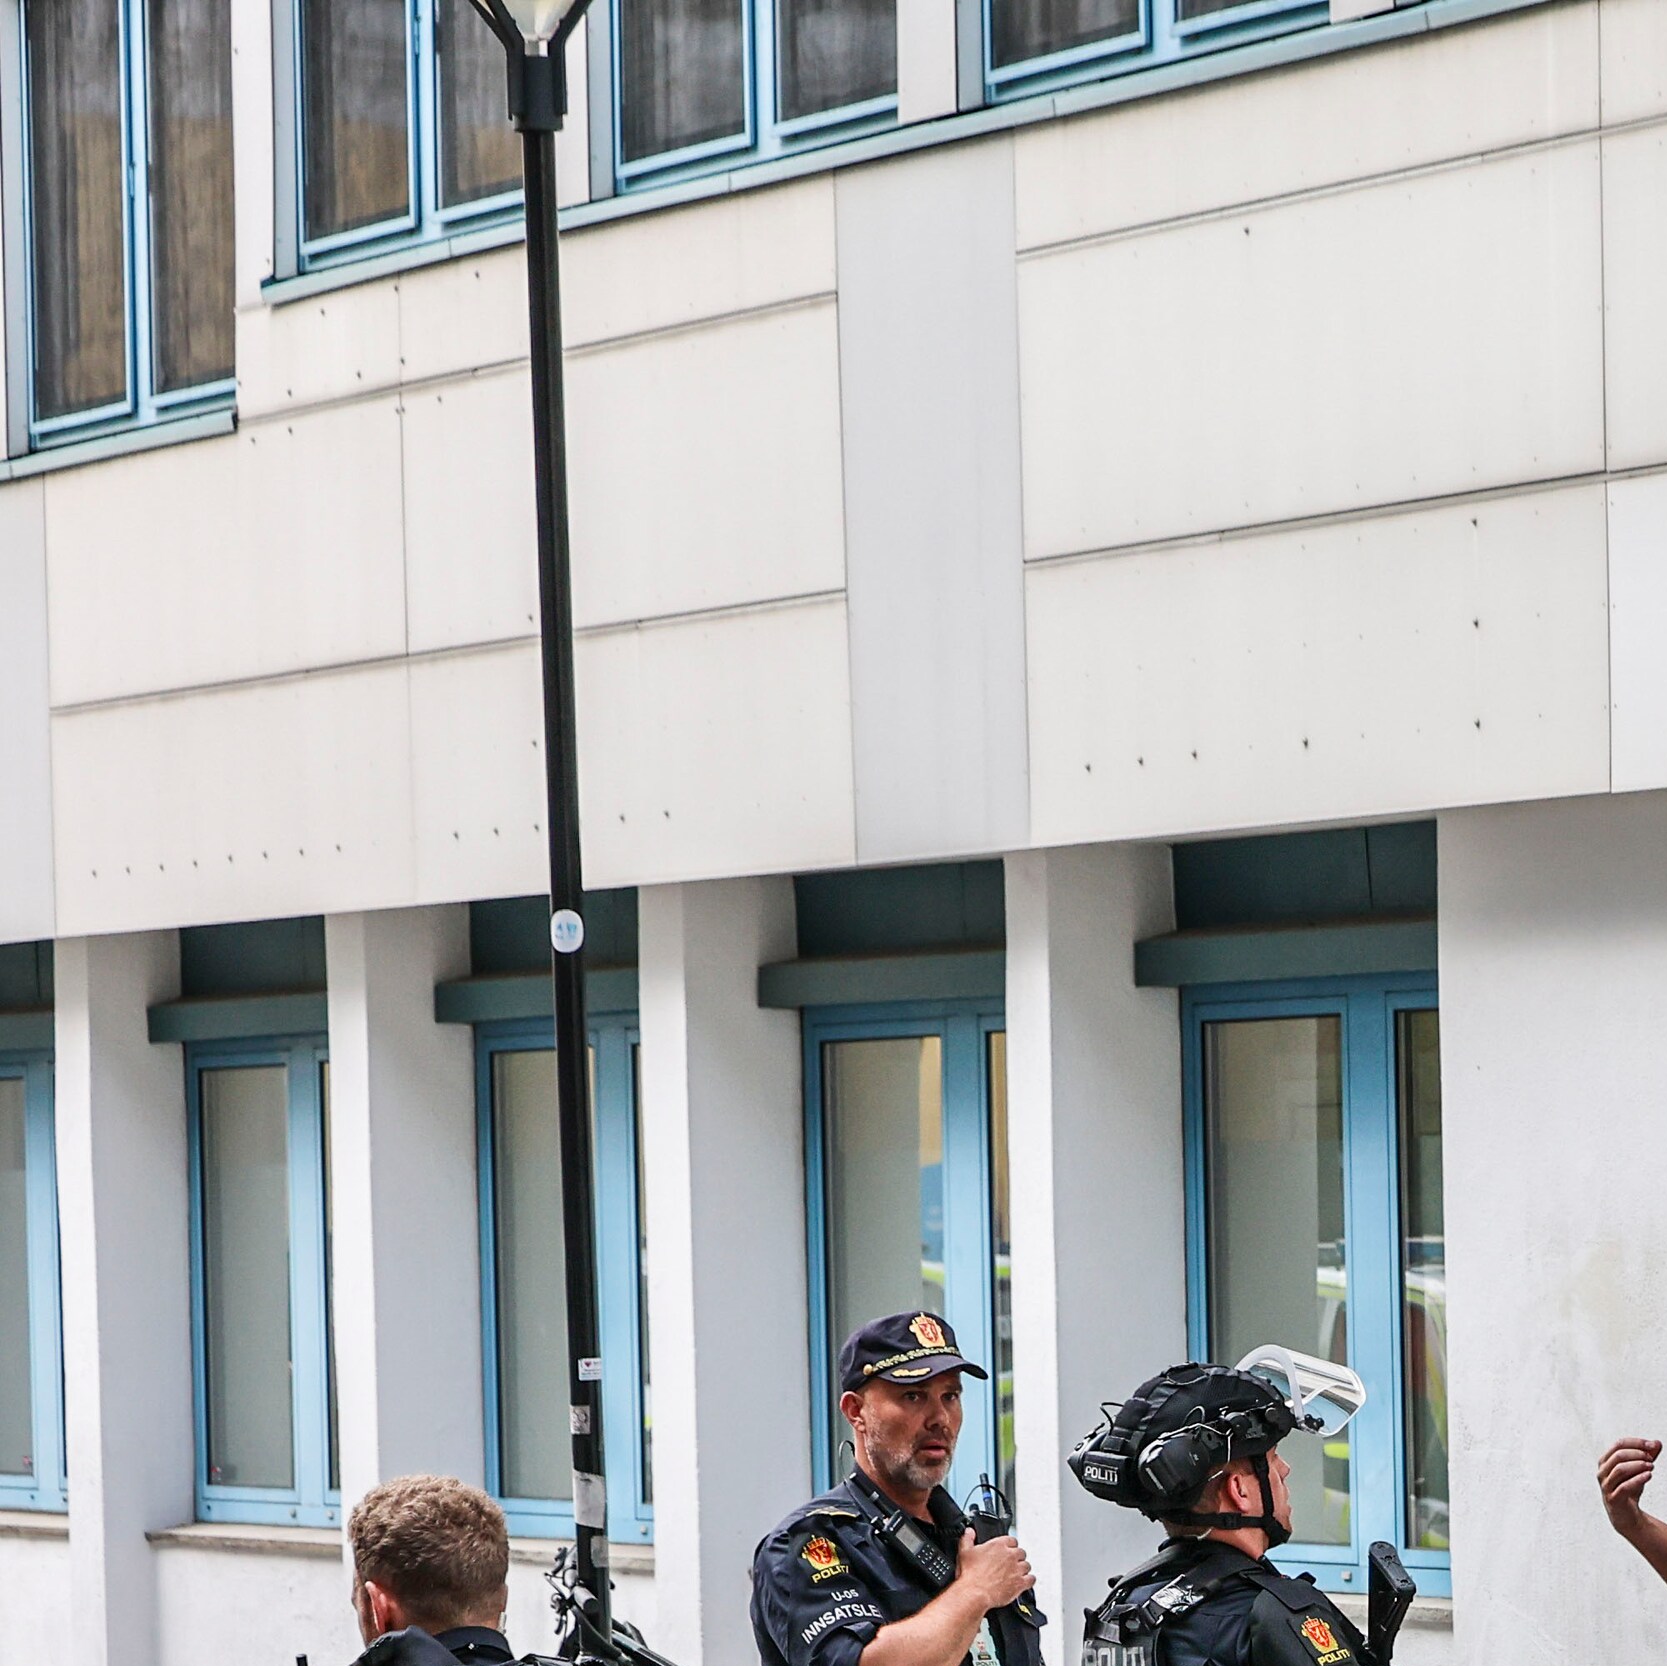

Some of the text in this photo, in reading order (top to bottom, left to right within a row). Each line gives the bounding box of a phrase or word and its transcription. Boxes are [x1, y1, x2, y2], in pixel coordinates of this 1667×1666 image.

[1084, 1465, 1119, 1483] POLITI
[812, 1565, 850, 1584] POLITI
[830, 1588, 860, 1602] U-05
[1317, 1648, 1351, 1666] POLITI
